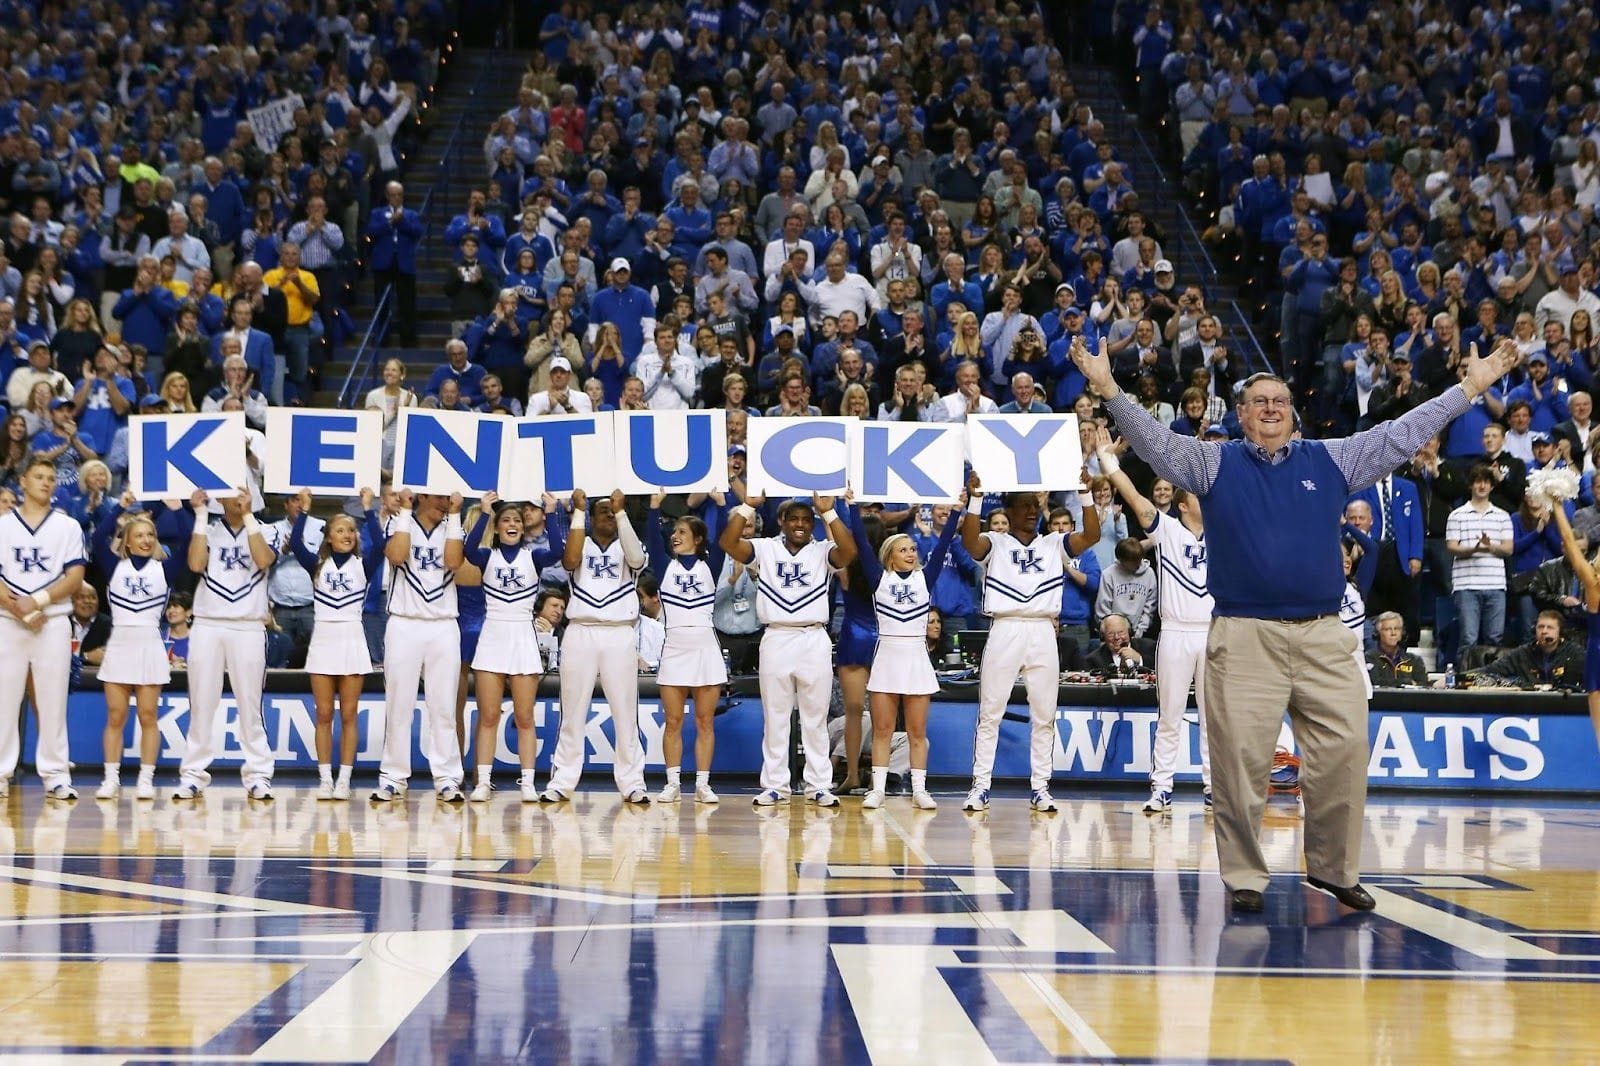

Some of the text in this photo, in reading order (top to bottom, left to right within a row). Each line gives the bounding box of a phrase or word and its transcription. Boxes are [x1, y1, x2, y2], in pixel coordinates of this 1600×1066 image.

[13, 547, 50, 572] UK
[219, 546, 250, 570] UK
[412, 545, 445, 571] UK
[586, 555, 619, 579] UK
[1010, 549, 1046, 574] UK
[324, 572, 353, 592] UK
[495, 567, 525, 588] UK
[673, 574, 704, 595] UK
[775, 560, 811, 588] UK
[124, 576, 153, 597] UK
[889, 583, 918, 605] UK
[1052, 710, 1546, 782] WILATS
